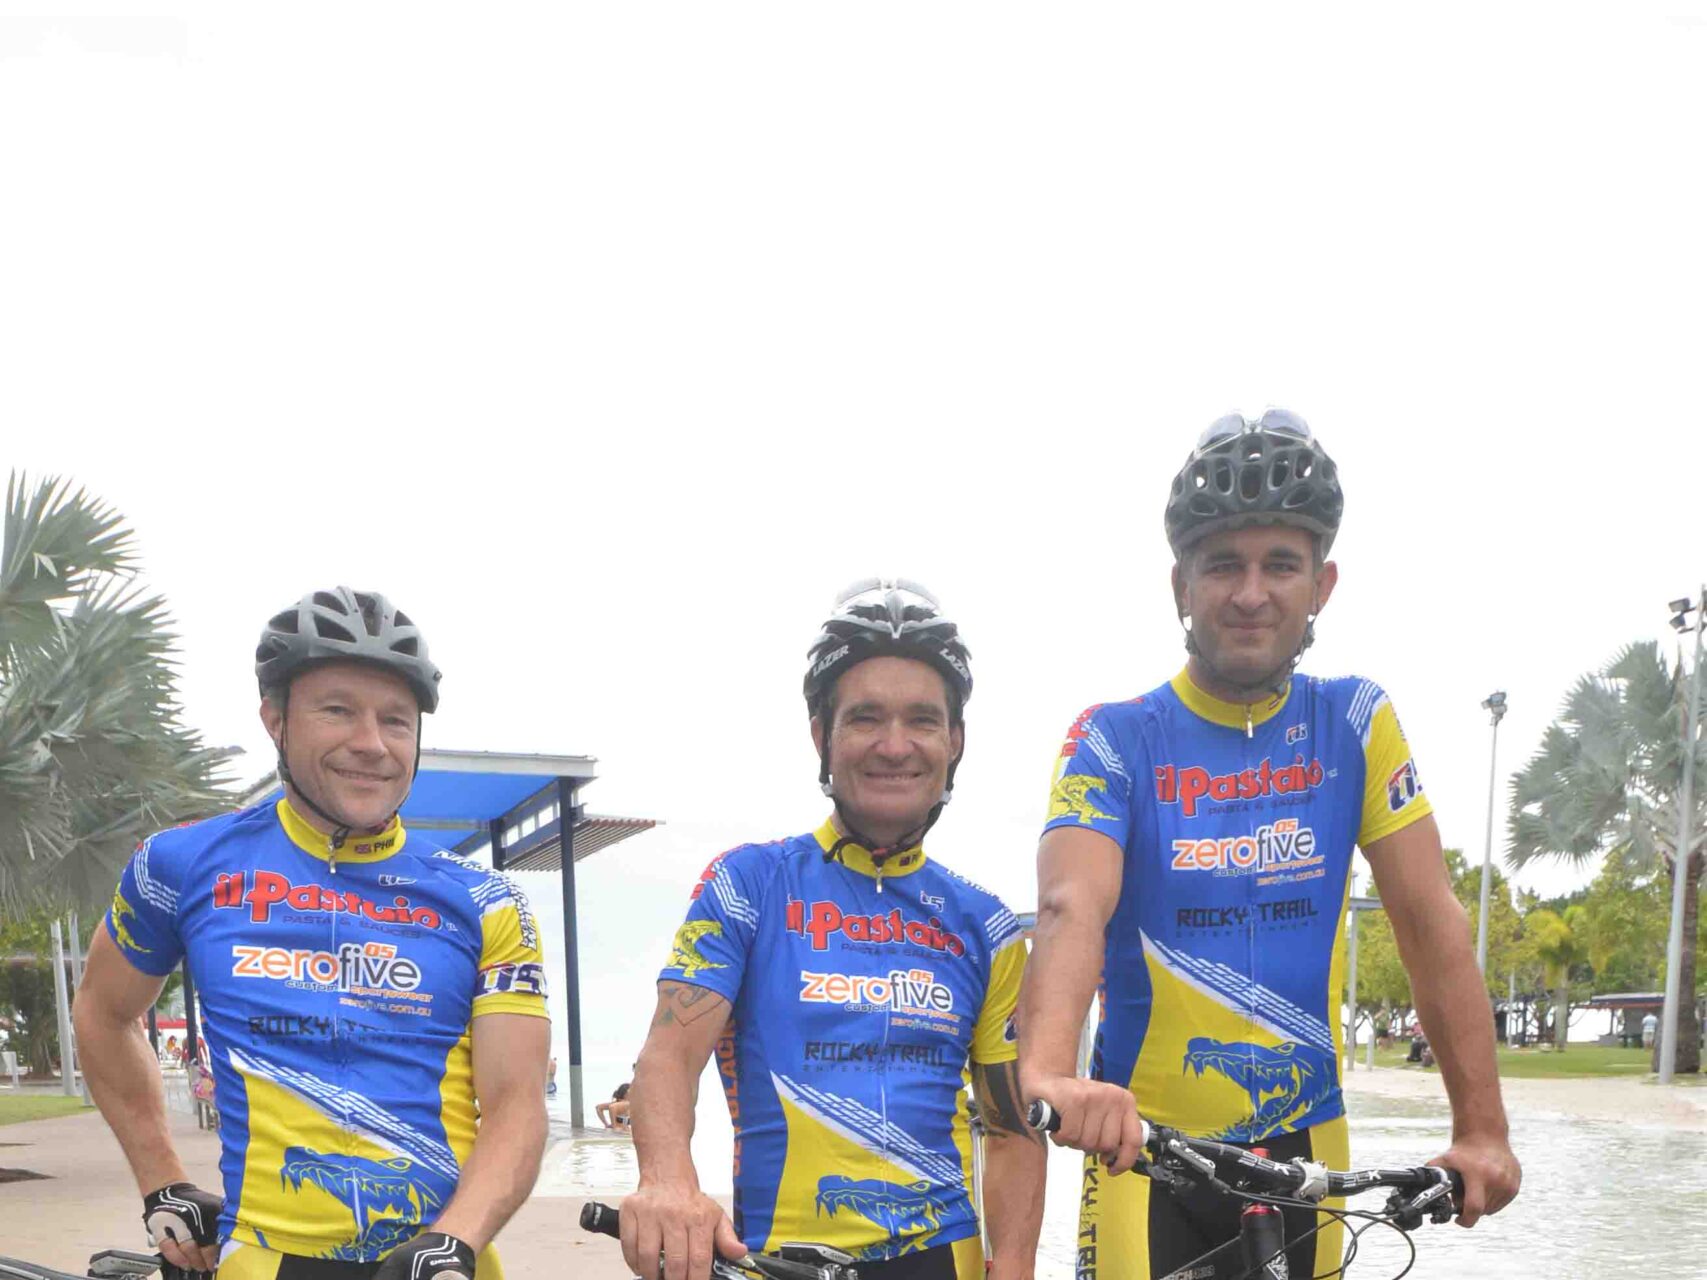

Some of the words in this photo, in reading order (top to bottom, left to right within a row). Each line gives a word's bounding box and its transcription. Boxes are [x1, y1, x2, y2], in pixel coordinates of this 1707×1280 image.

[813, 645, 849, 677] LAZER
[1179, 753, 1325, 818] Pastaio
[1171, 825, 1316, 872] zerofive
[245, 870, 442, 930] Pastaio
[1176, 905, 1249, 928] ROCKY
[1258, 897, 1319, 922] TRAIL
[806, 901, 966, 959] Pastaio
[232, 943, 422, 992] zerofive
[800, 969, 953, 1012] zerofive
[804, 1041, 879, 1063] ROCKY
[888, 1043, 950, 1066] TRAIL
